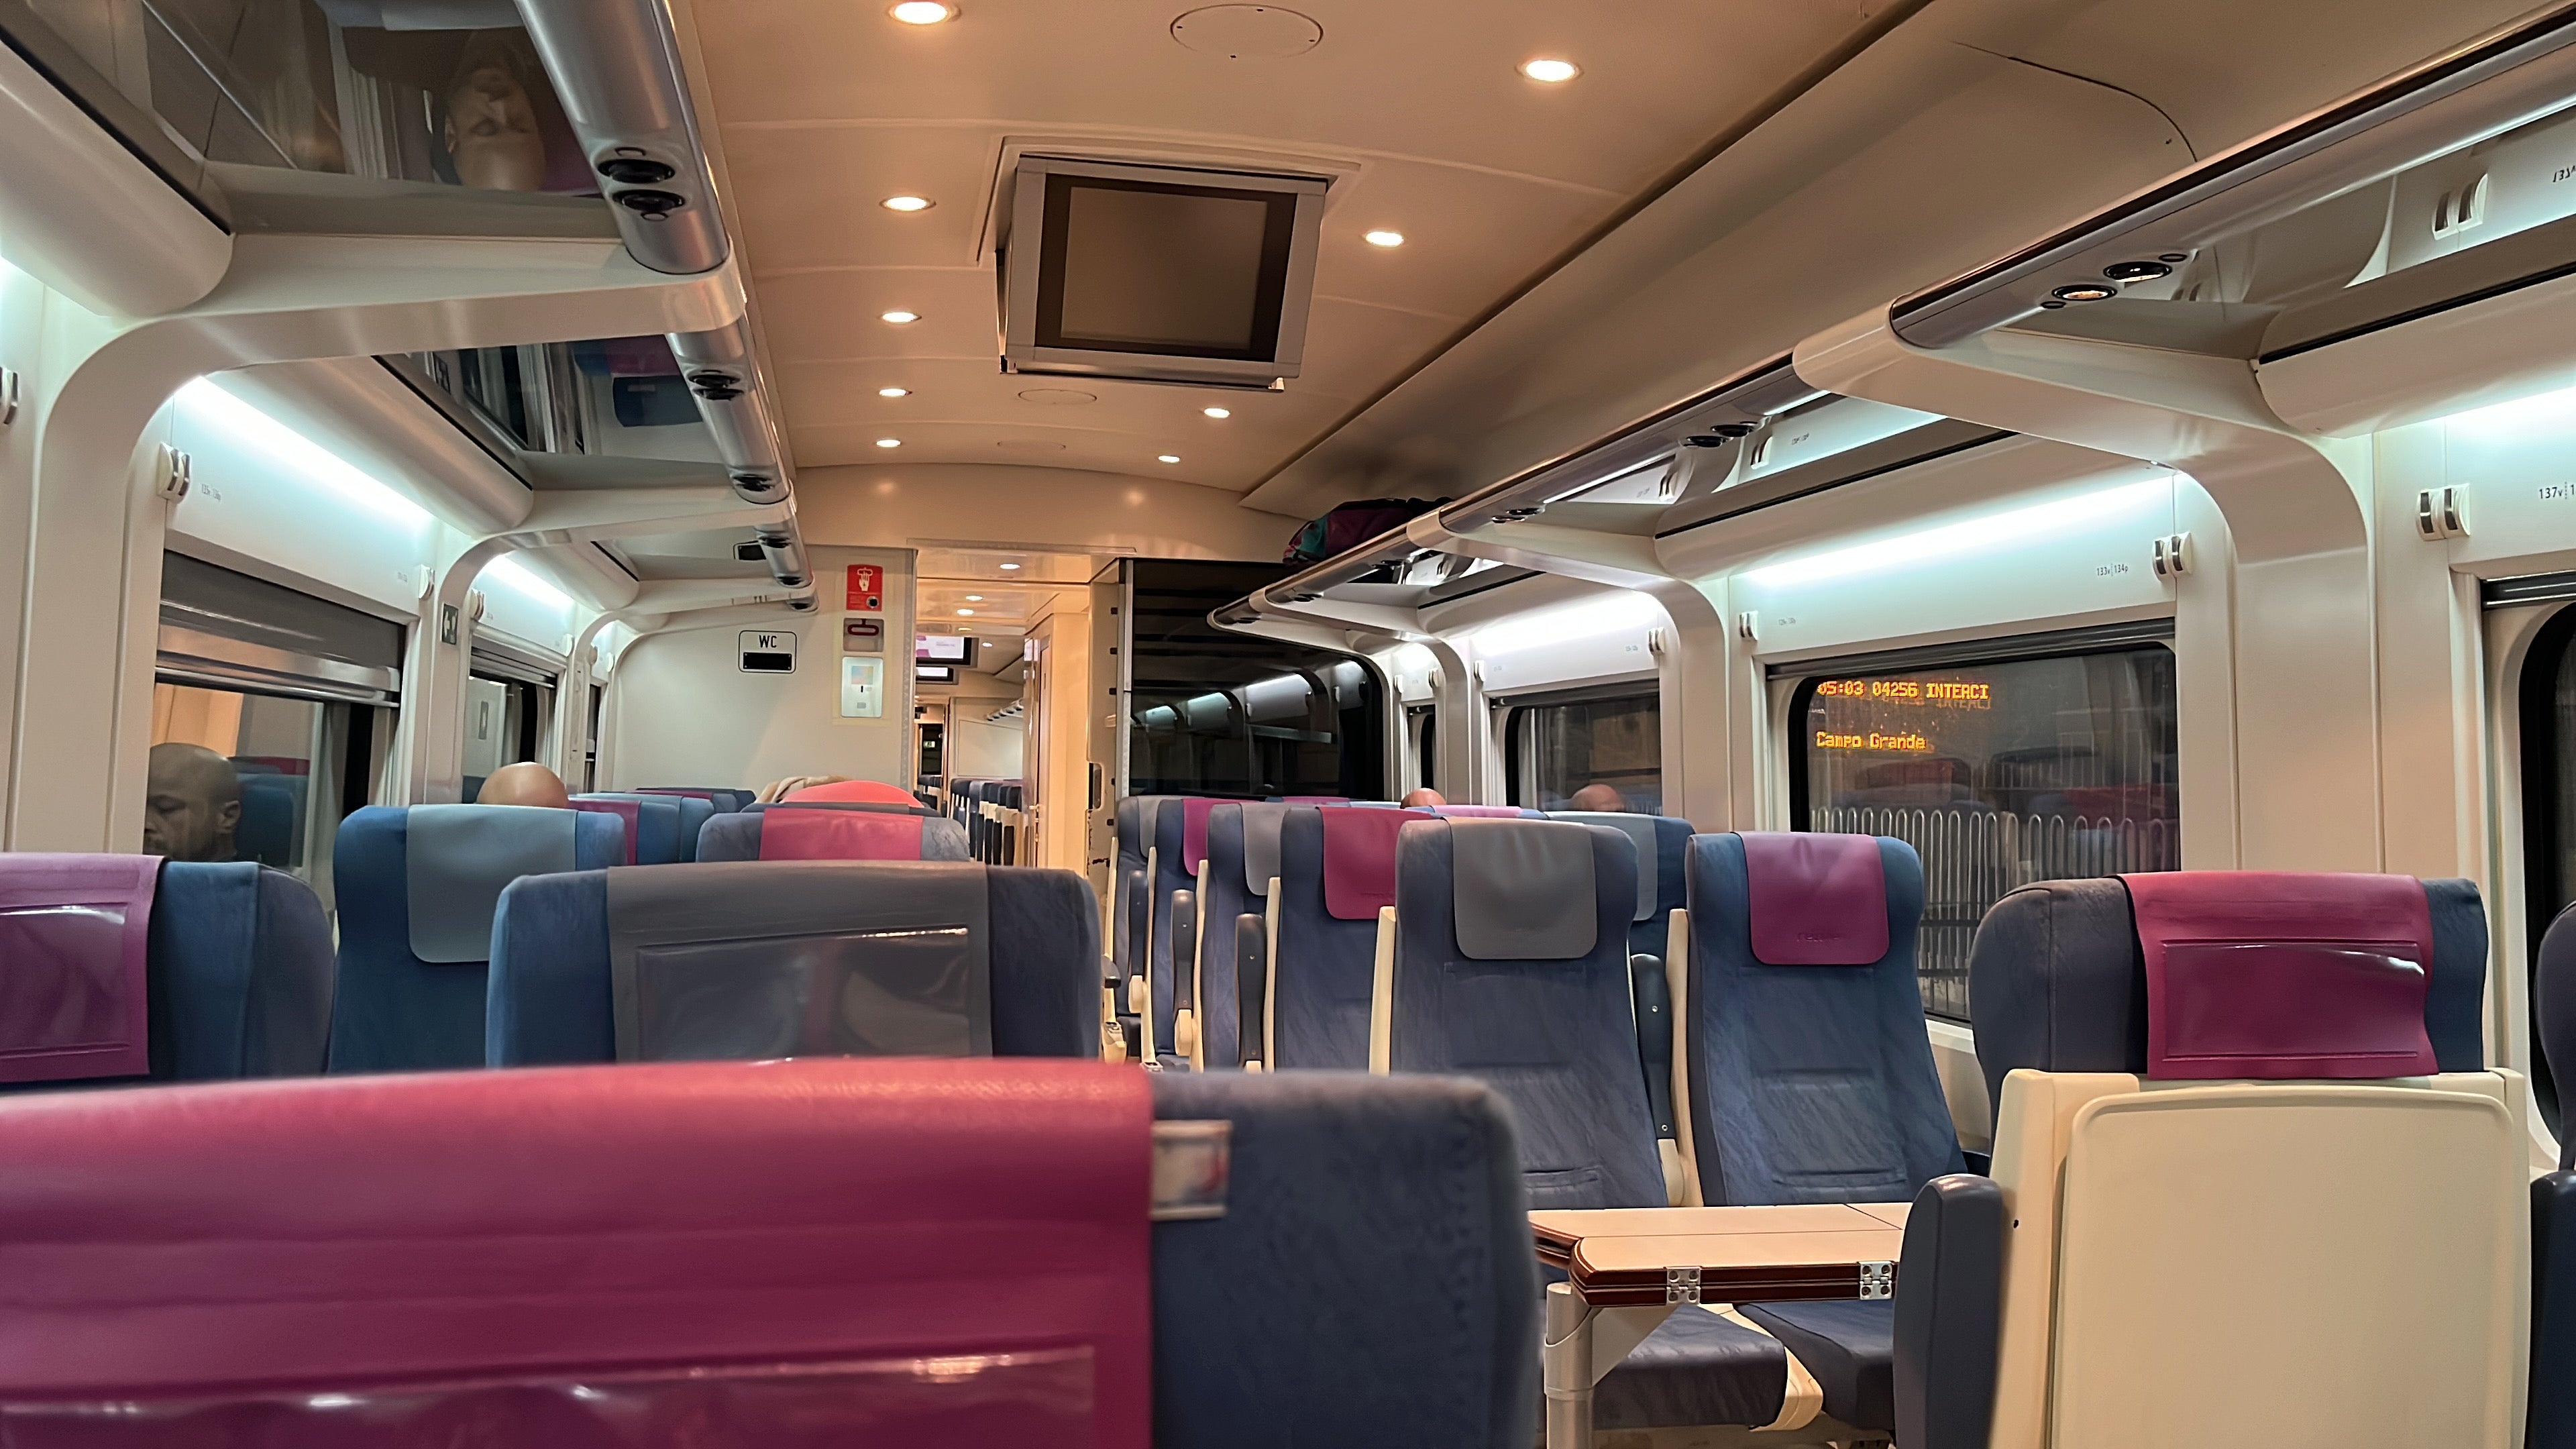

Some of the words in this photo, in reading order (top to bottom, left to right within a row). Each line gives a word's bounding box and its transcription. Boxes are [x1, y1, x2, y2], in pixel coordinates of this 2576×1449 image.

[2539, 486, 2563, 499] 137v
[2097, 566, 2110, 576] 133v
[2114, 564, 2129, 574] 134p
[759, 635, 777, 648] WC
[1817, 680, 1864, 696] 05:03
[1872, 681, 1919, 698] 04256
[1926, 683, 1990, 700] INTERCI
[1816, 731, 1863, 748] Campo
[1870, 732, 1926, 749] Grande
